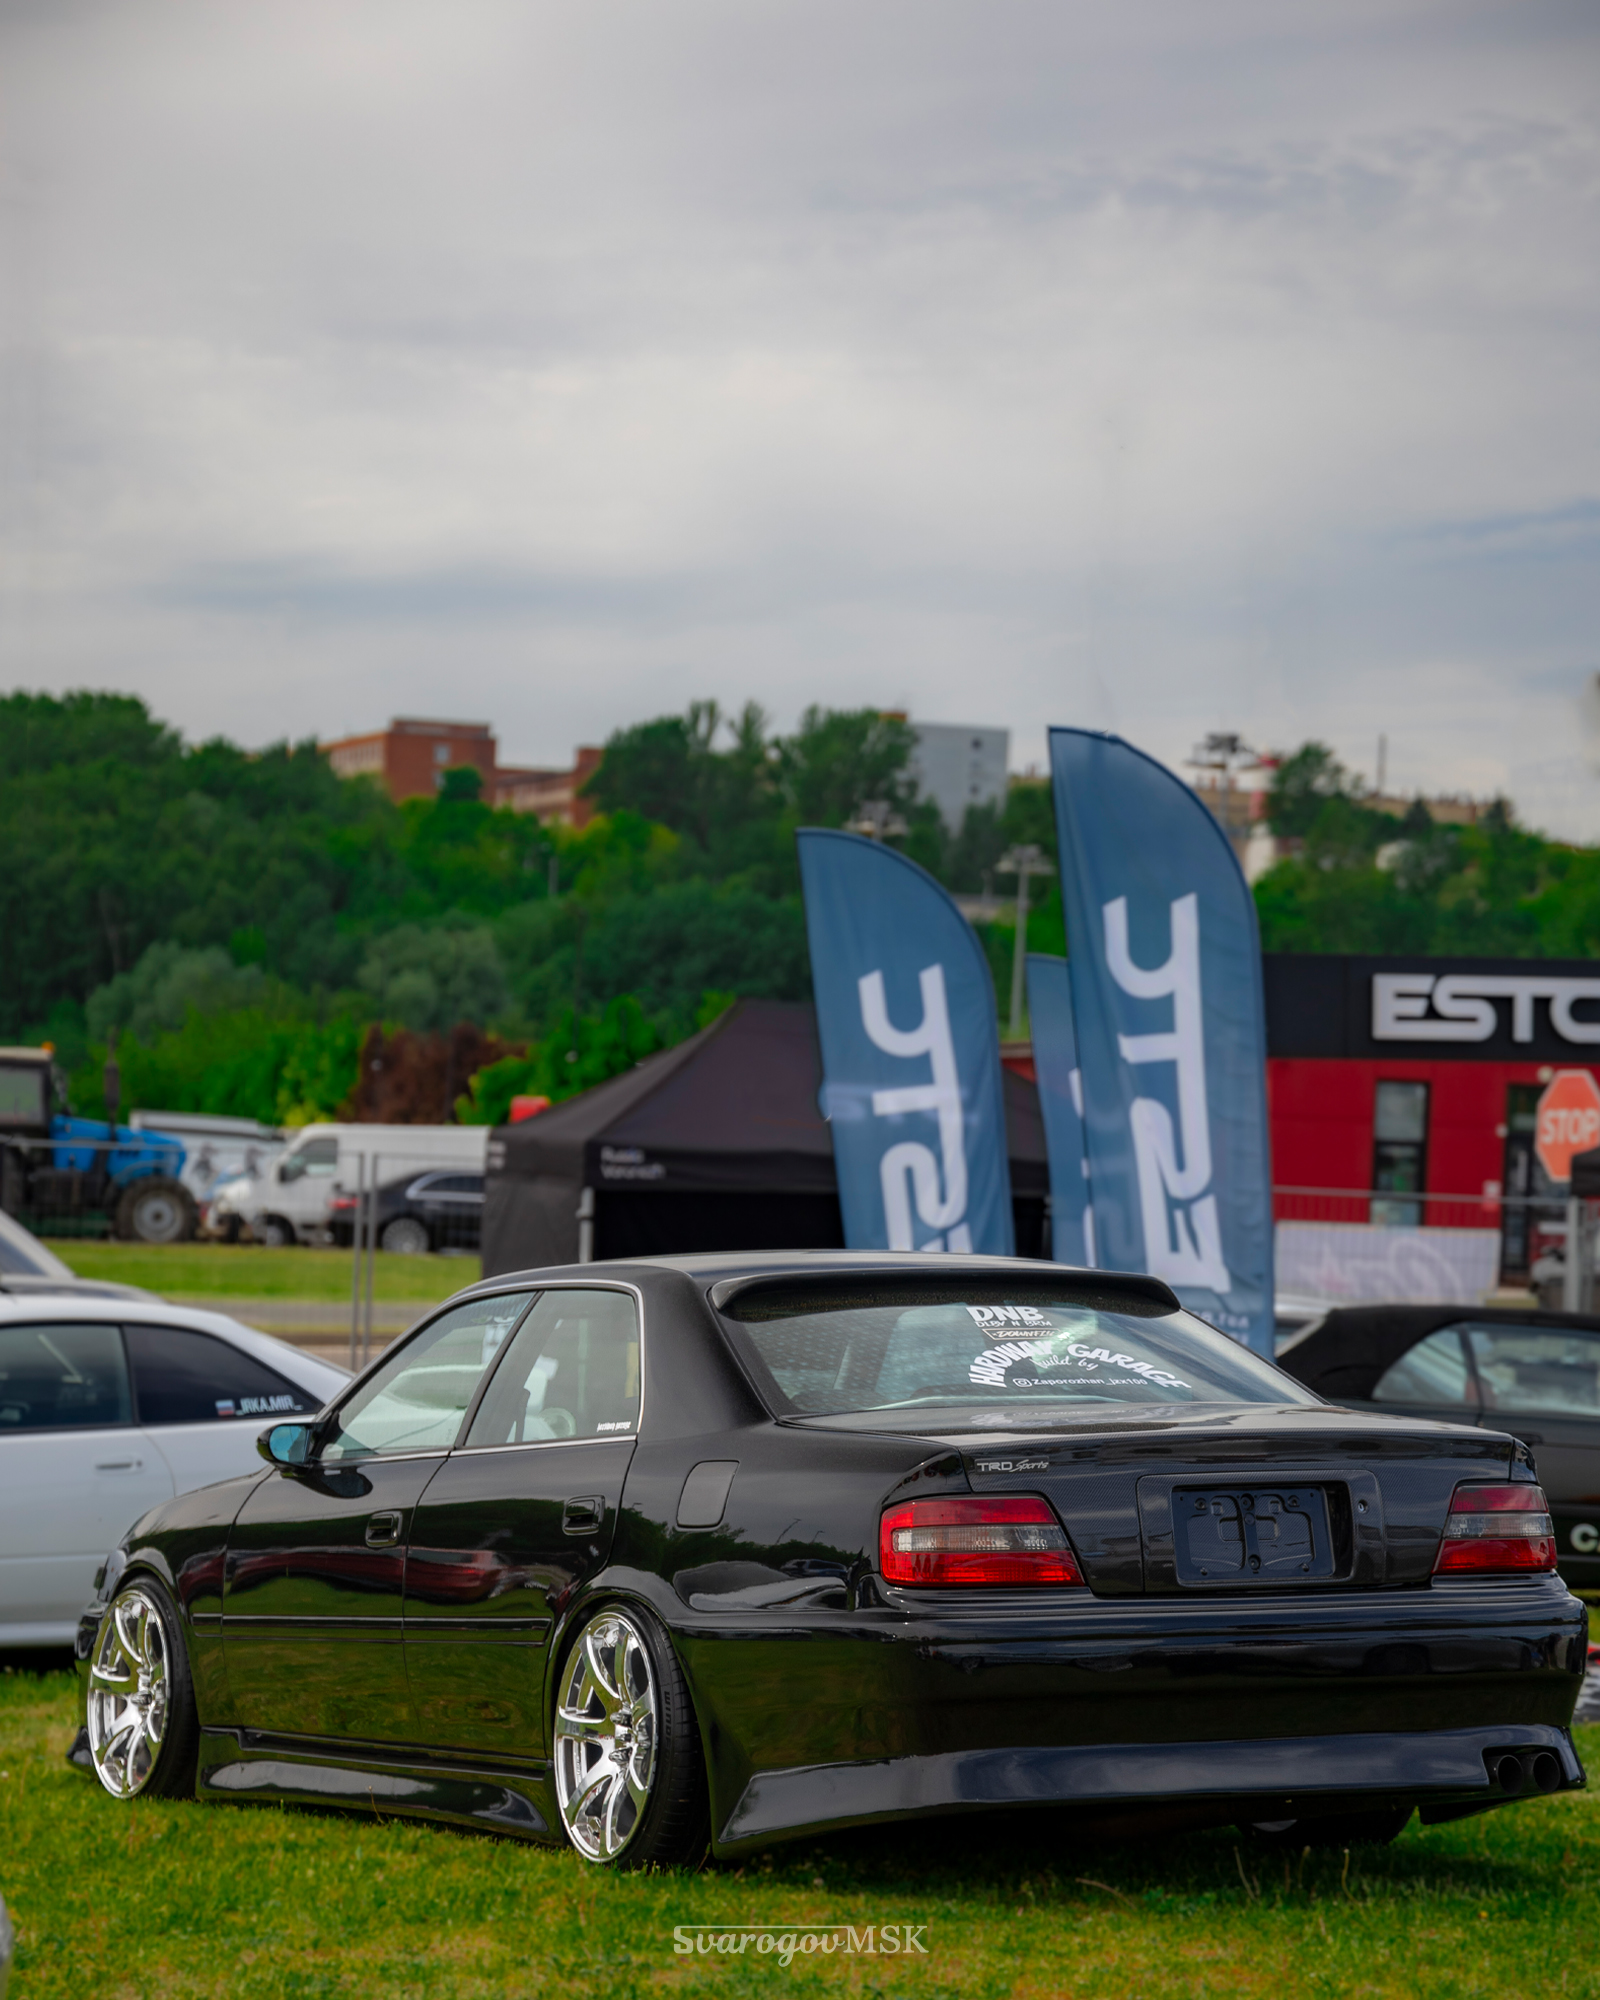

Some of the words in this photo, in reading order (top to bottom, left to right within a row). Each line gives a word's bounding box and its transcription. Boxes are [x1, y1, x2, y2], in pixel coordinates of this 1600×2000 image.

[1541, 1108, 1599, 1144] STOP
[966, 1305, 1044, 1322] DNB
[1067, 1343, 1192, 1389] GARAGE
[1078, 1358, 1099, 1371] by
[976, 1461, 1013, 1471] TRD
[1009, 1459, 1049, 1472] Sports
